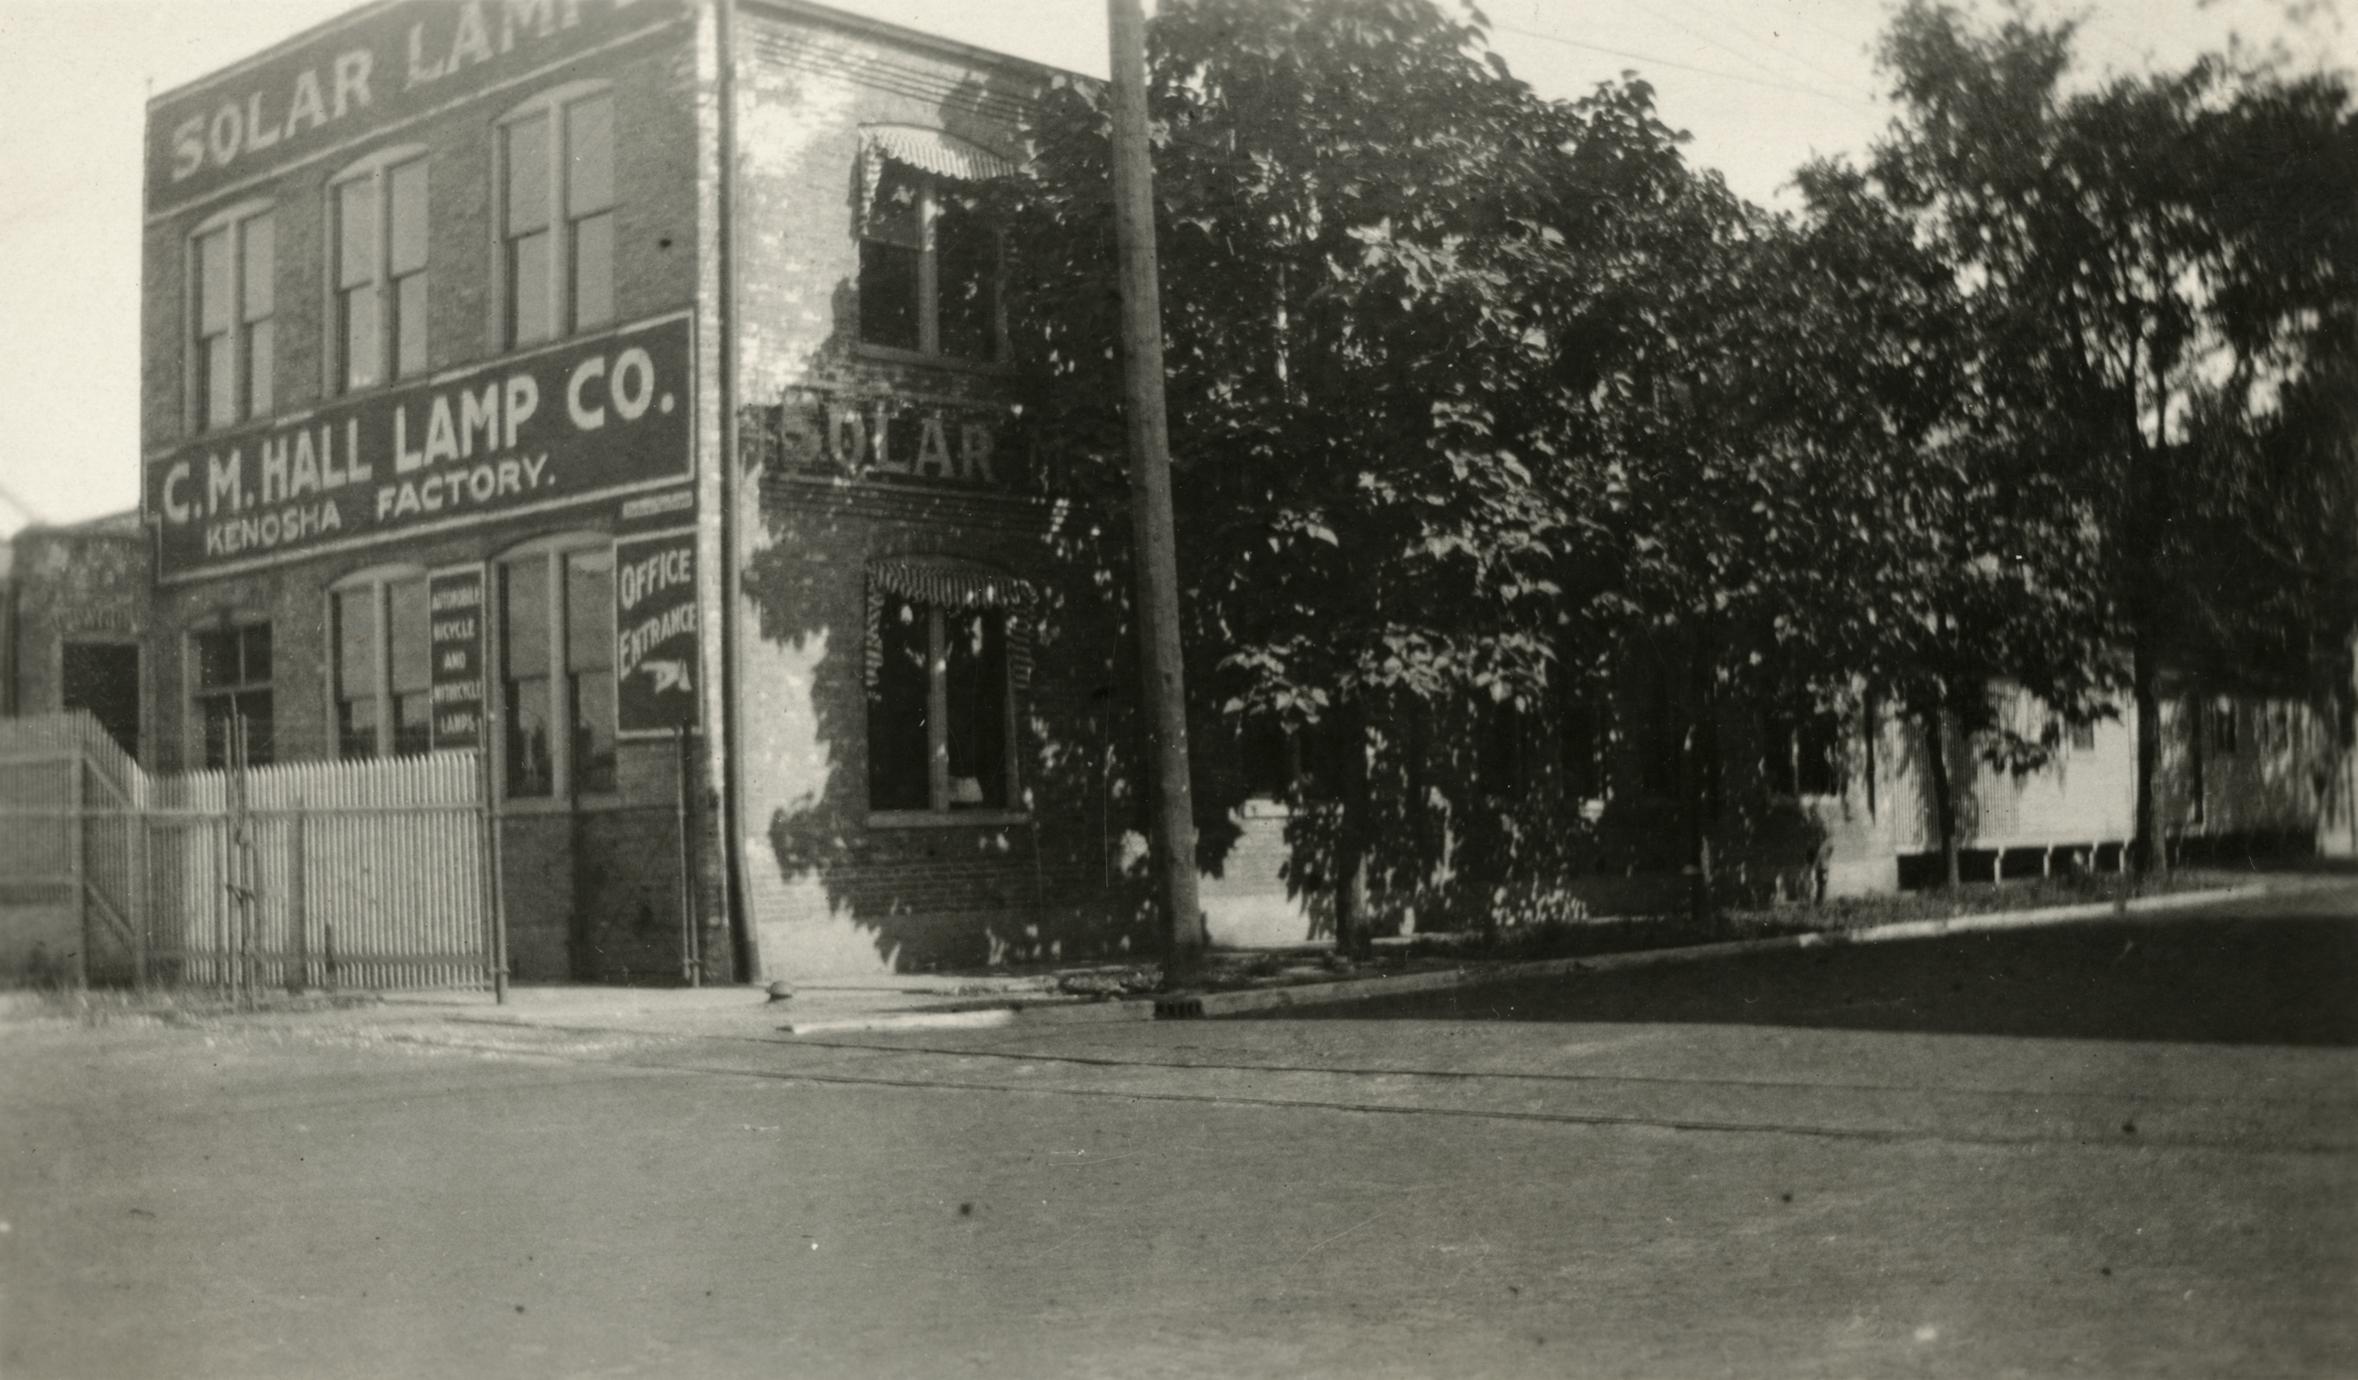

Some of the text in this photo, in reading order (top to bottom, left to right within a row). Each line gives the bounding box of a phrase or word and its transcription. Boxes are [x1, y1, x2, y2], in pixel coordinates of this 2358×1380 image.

[170, 0, 639, 183] SOLAR LAM
[396, 375, 540, 472] LAMP
[567, 347, 675, 430] CO.
[782, 389, 996, 482] SOLAR
[205, 500, 342, 556] KENOSHA
[376, 454, 556, 520] FACTORY.
[621, 549, 692, 610] OFFICE
[443, 650, 467, 671] AND
[619, 603, 697, 681] ENTRANCE
